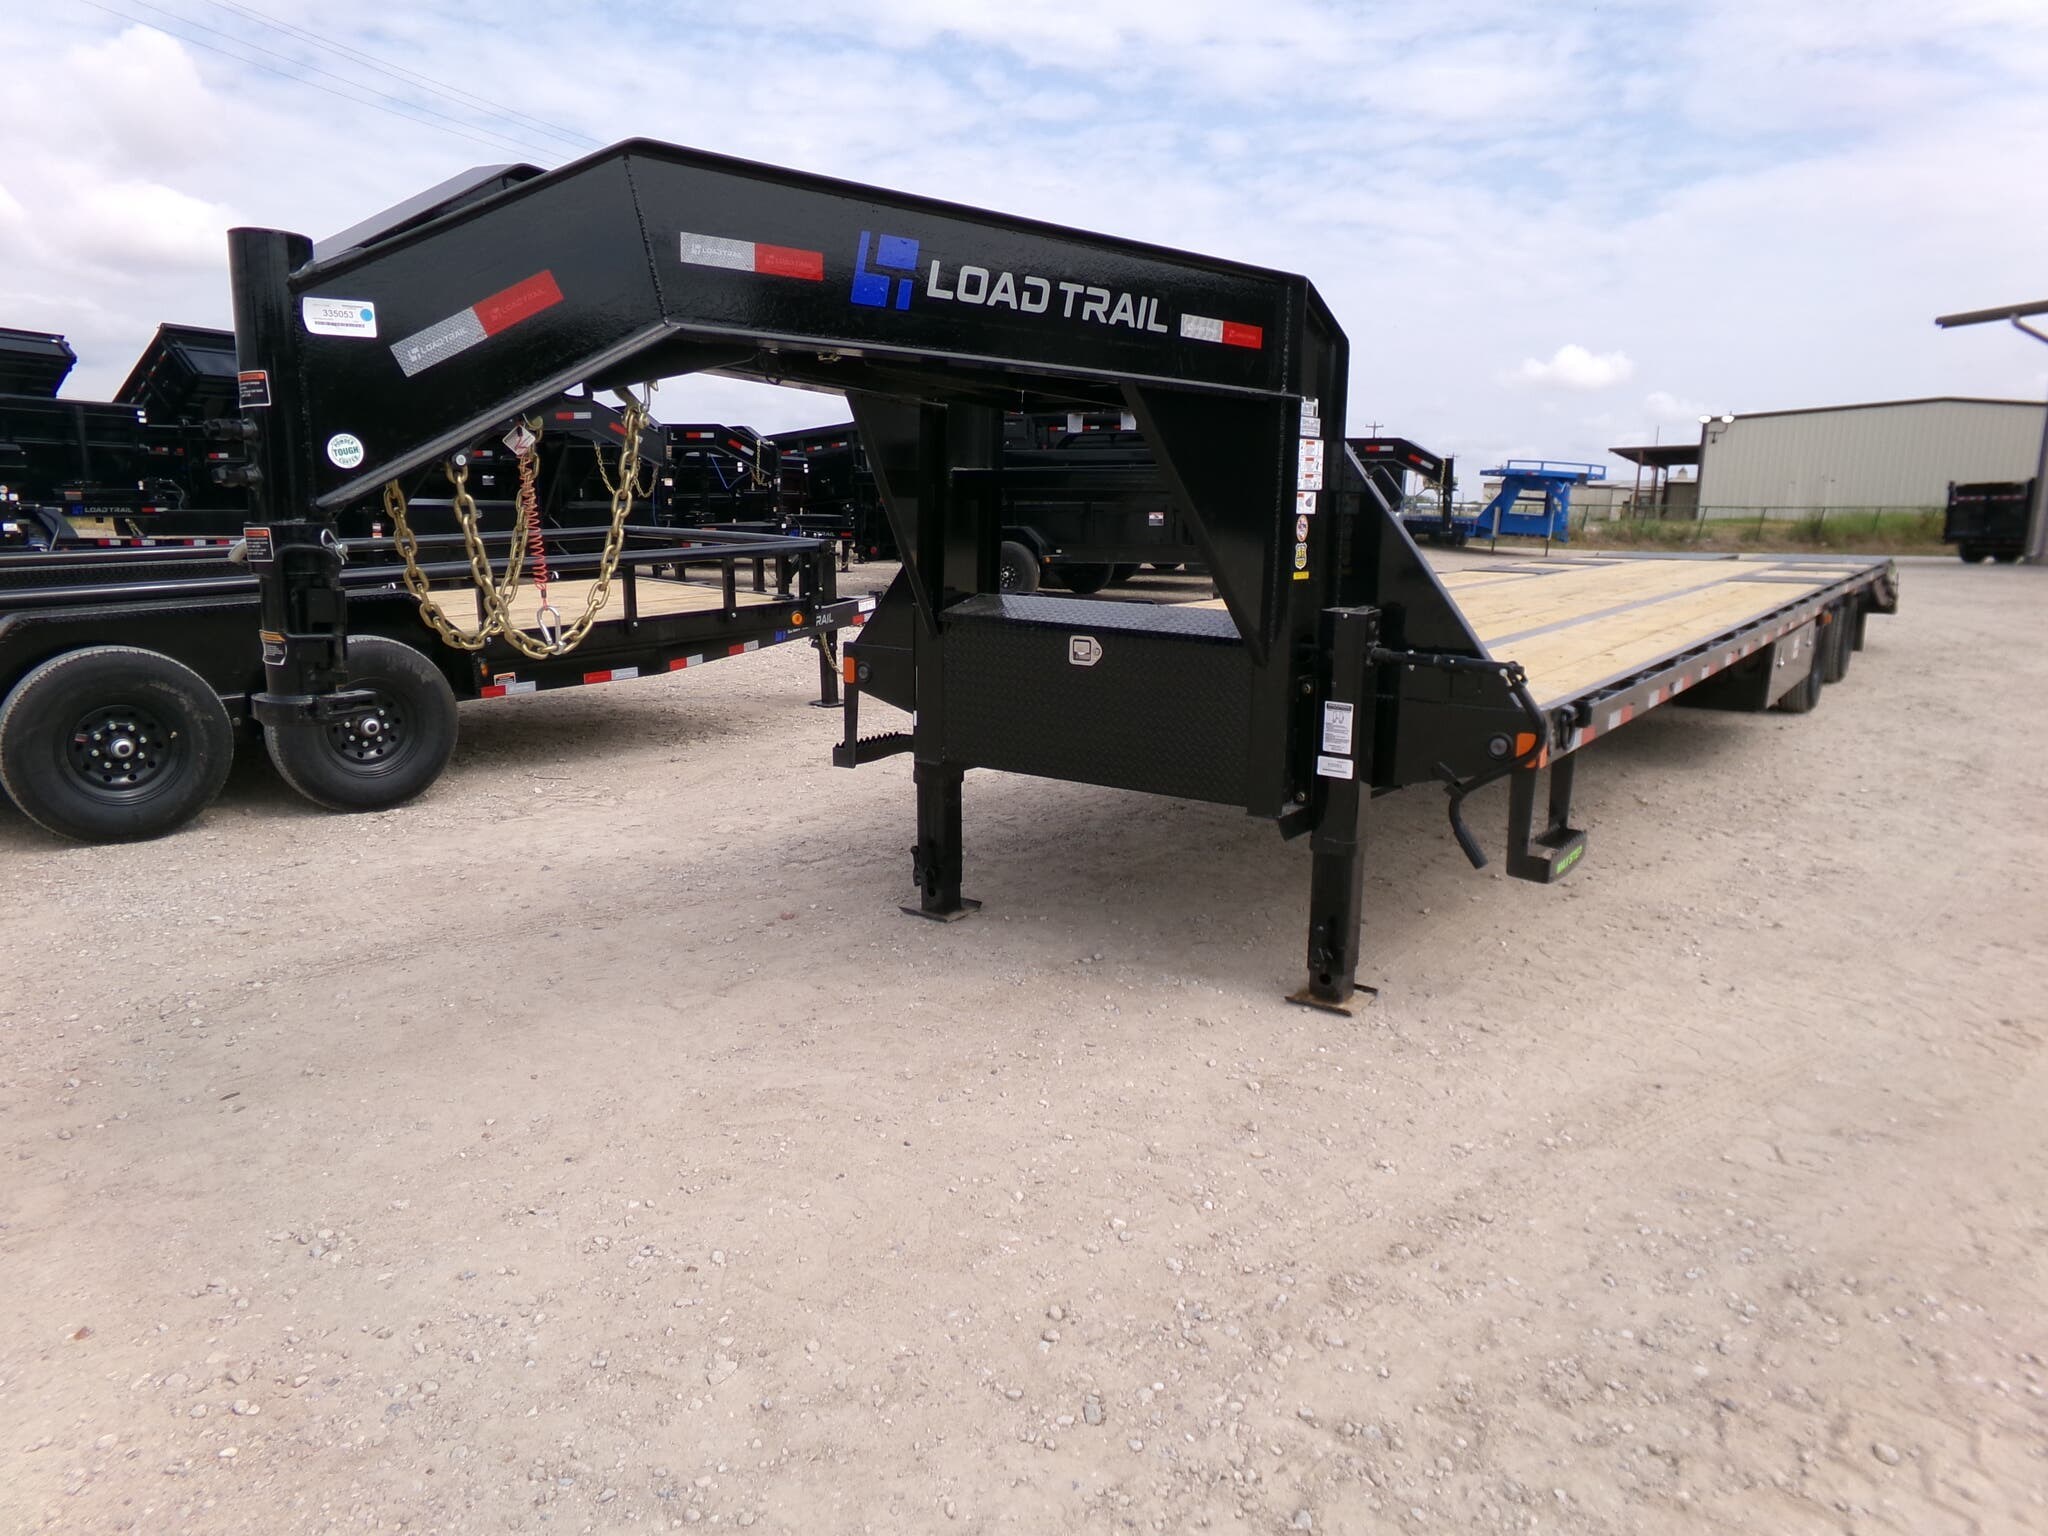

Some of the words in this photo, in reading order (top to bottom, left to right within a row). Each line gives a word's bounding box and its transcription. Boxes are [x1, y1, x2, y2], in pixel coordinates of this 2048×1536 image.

[926, 260, 1051, 313] LOAD
[1058, 282, 1168, 333] TRAIL
[322, 309, 354, 319] 335053
[333, 446, 359, 457] TOUGH
[815, 612, 834, 627] RAIL
